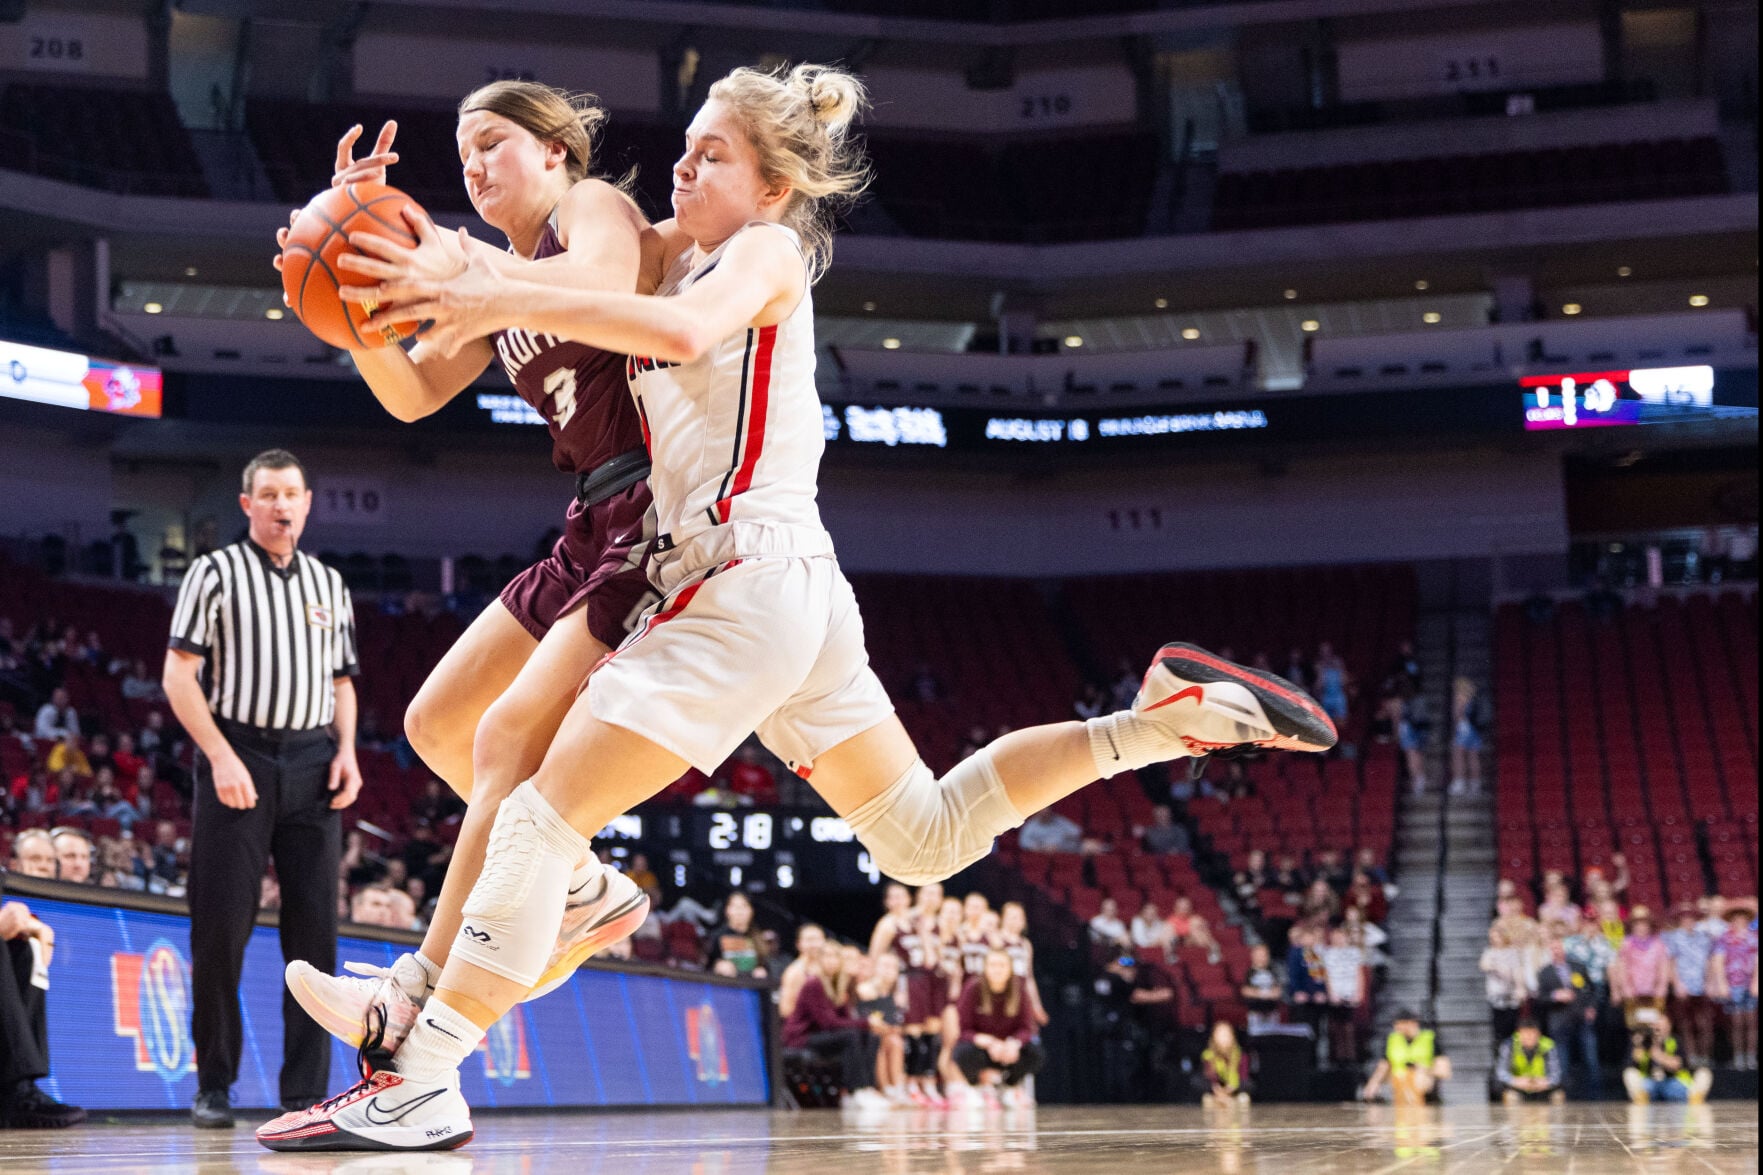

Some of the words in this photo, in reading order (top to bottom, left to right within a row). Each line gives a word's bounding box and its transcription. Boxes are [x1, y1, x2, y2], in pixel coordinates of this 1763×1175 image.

[30, 37, 83, 60] 208
[1446, 58, 1500, 80] 211
[1022, 96, 1072, 117] 210
[544, 366, 577, 431] 3
[324, 489, 380, 513] 110
[1105, 509, 1161, 531] 111
